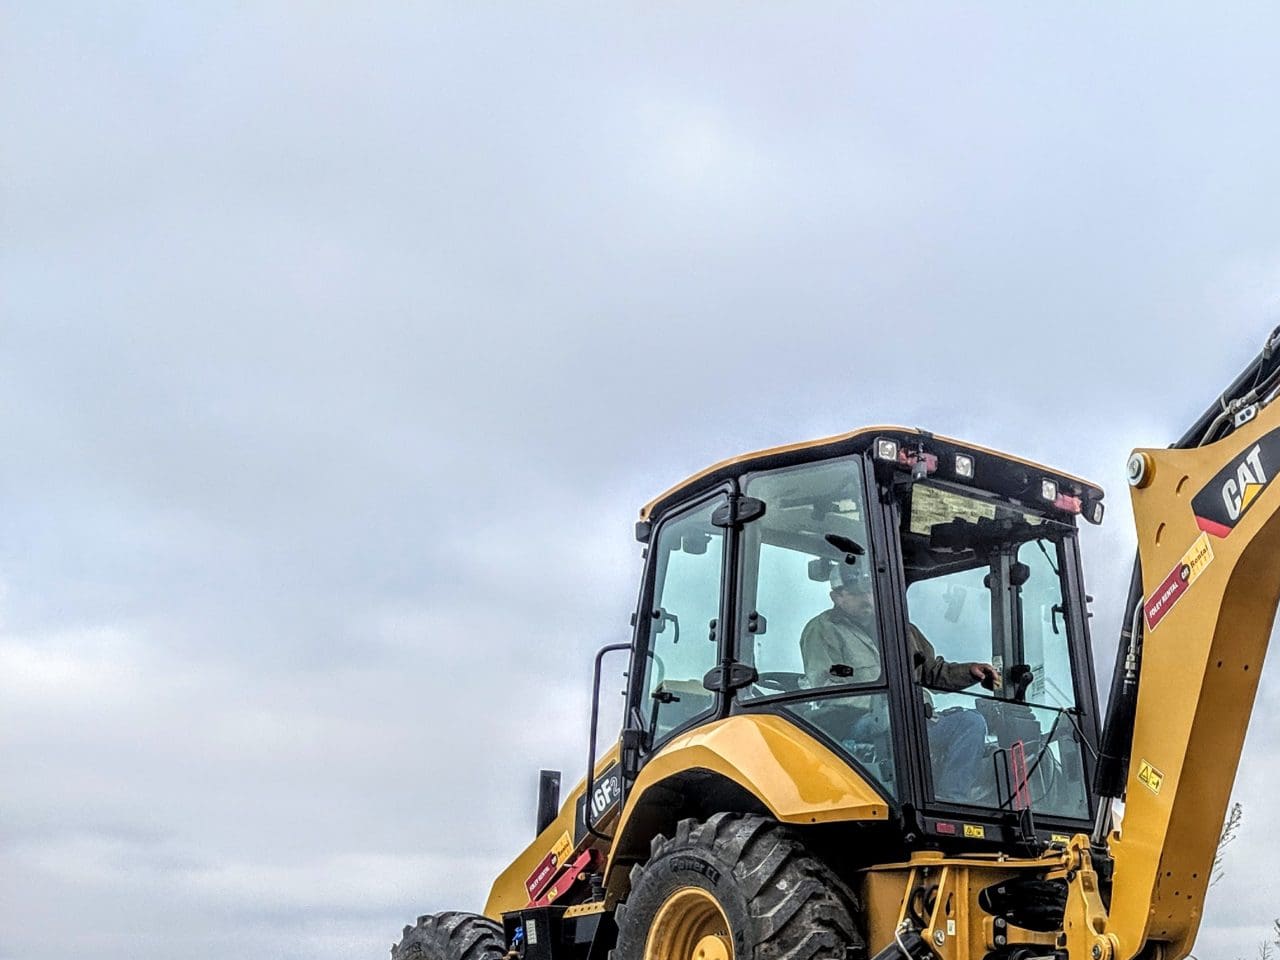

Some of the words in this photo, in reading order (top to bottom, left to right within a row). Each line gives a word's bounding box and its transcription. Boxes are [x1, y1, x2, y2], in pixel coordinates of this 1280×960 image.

[1222, 444, 1267, 520] CAT
[1149, 599, 1163, 618] FOLEY
[1162, 581, 1179, 604] RENTAL
[582, 776, 621, 825] 16F2
